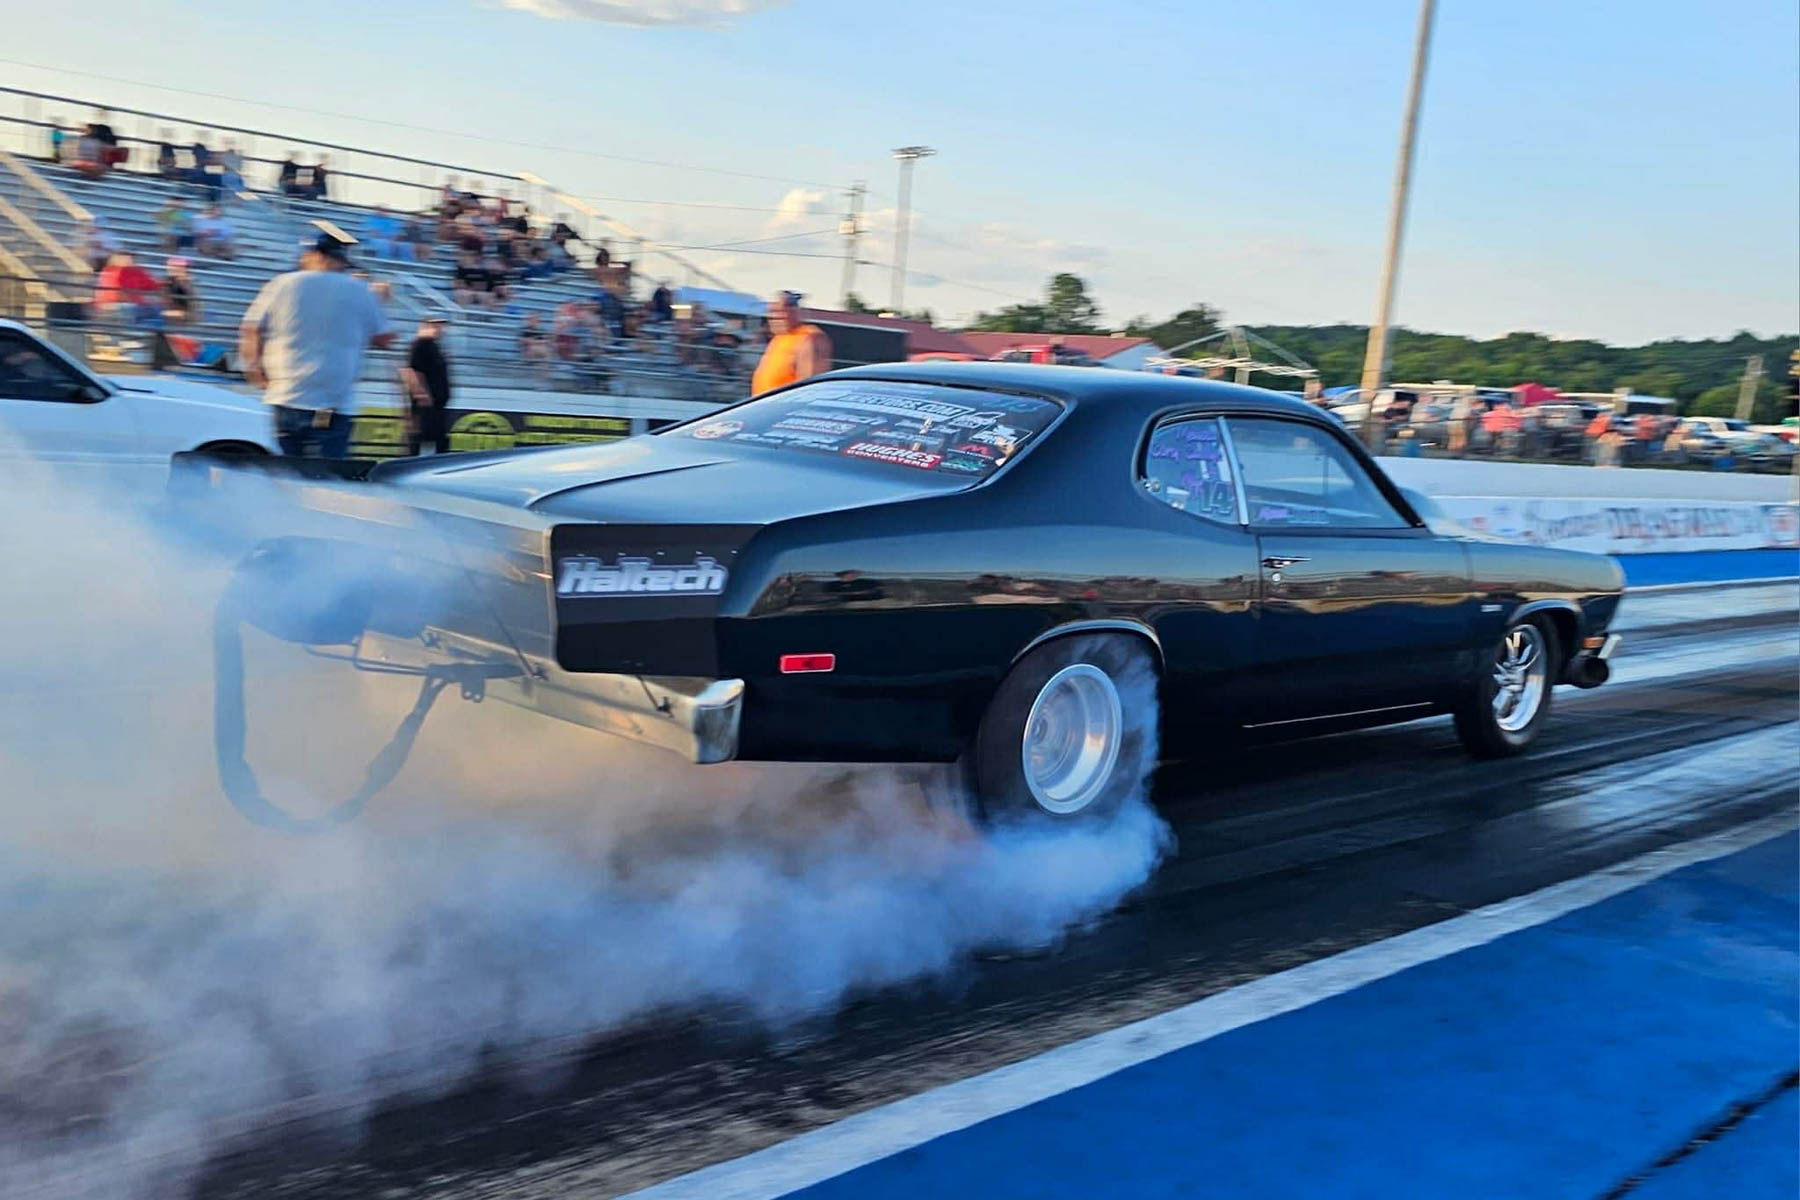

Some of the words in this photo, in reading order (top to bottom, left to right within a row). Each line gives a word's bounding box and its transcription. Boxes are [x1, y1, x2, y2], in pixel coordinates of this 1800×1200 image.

[846, 449, 930, 468] CONVERTERS
[850, 442, 943, 464] HUGHES
[557, 560, 727, 595] Haltech
